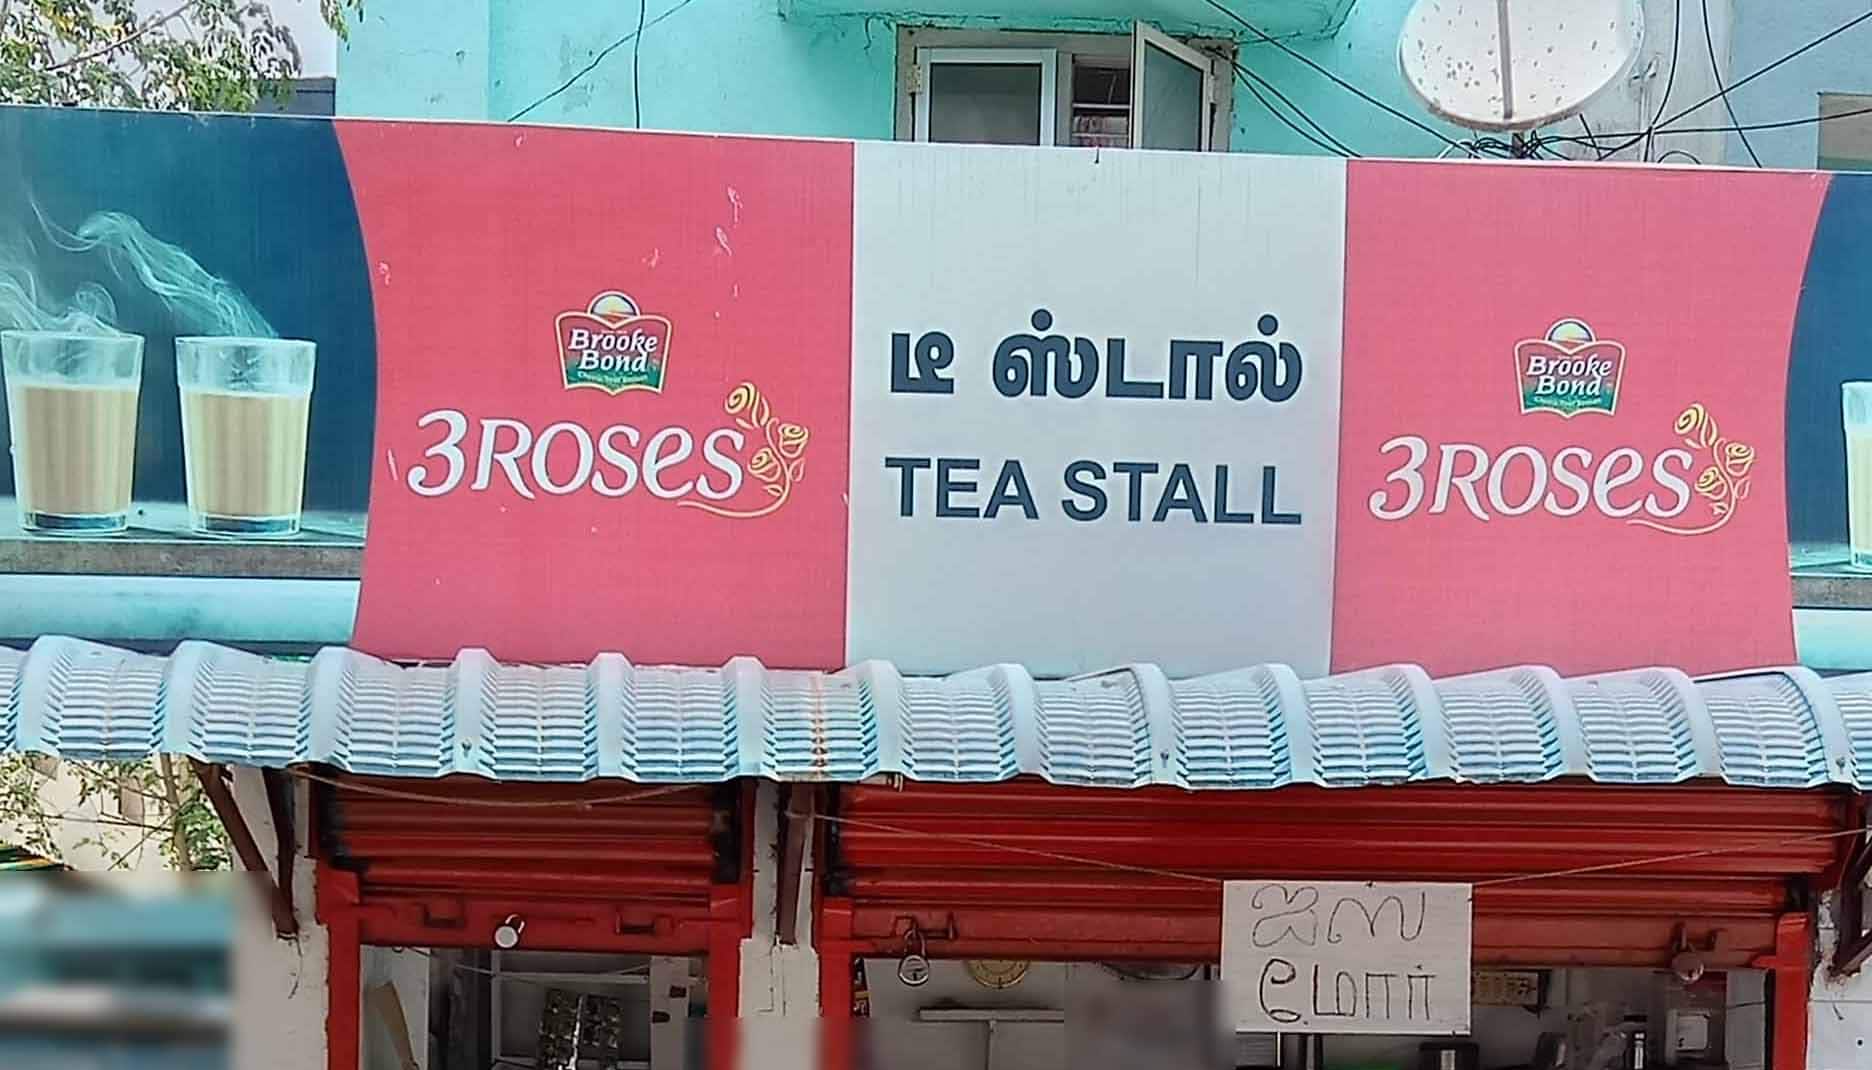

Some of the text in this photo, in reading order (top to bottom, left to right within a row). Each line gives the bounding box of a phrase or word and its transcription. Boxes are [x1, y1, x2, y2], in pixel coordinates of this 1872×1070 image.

[567, 328, 658, 353] Brooke
[578, 349, 649, 372] Bond
[890, 308, 1303, 402] டீ ஸ்டால்
[1525, 353, 1613, 377] Brooke
[1535, 375, 1602, 396] Bond
[885, 457, 1302, 525] TEA STALL
